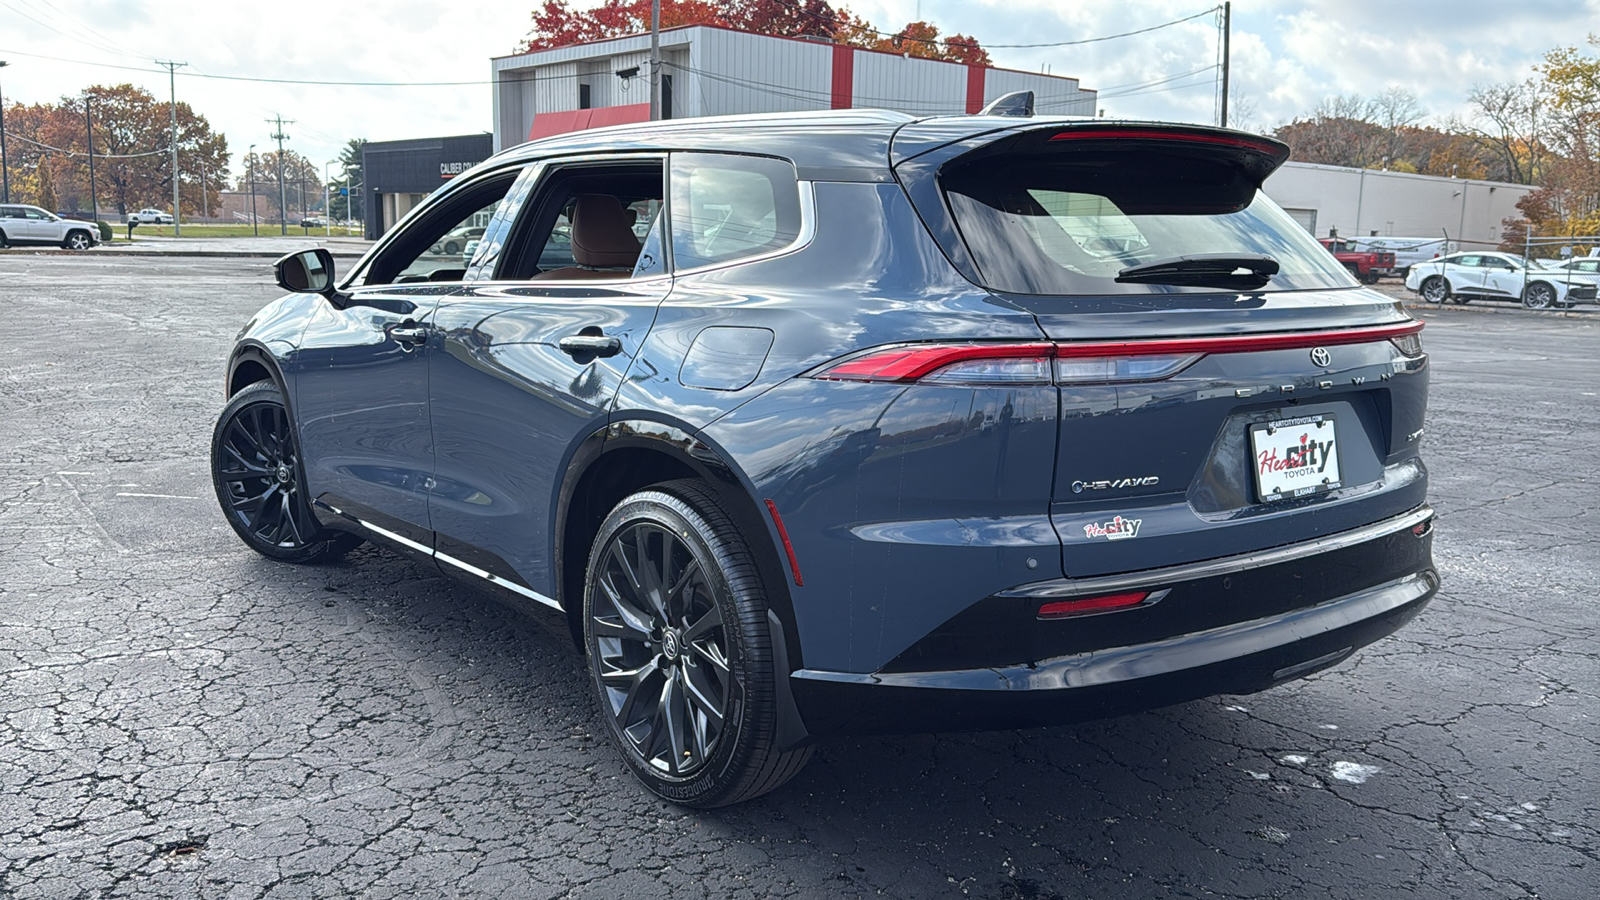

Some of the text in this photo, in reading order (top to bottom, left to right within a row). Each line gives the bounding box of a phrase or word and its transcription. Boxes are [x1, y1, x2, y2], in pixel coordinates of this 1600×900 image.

[440, 162, 462, 174] CALIBER
[1235, 373, 1392, 398] CROWN
[1268, 415, 1323, 428] HEARTCITYTOYOTA.COM
[1258, 447, 1312, 476] Heart
[1283, 467, 1316, 479] TOYOTA
[1294, 486, 1317, 497] ELKHART
[658, 773, 715, 799] BRIDGESTONE
